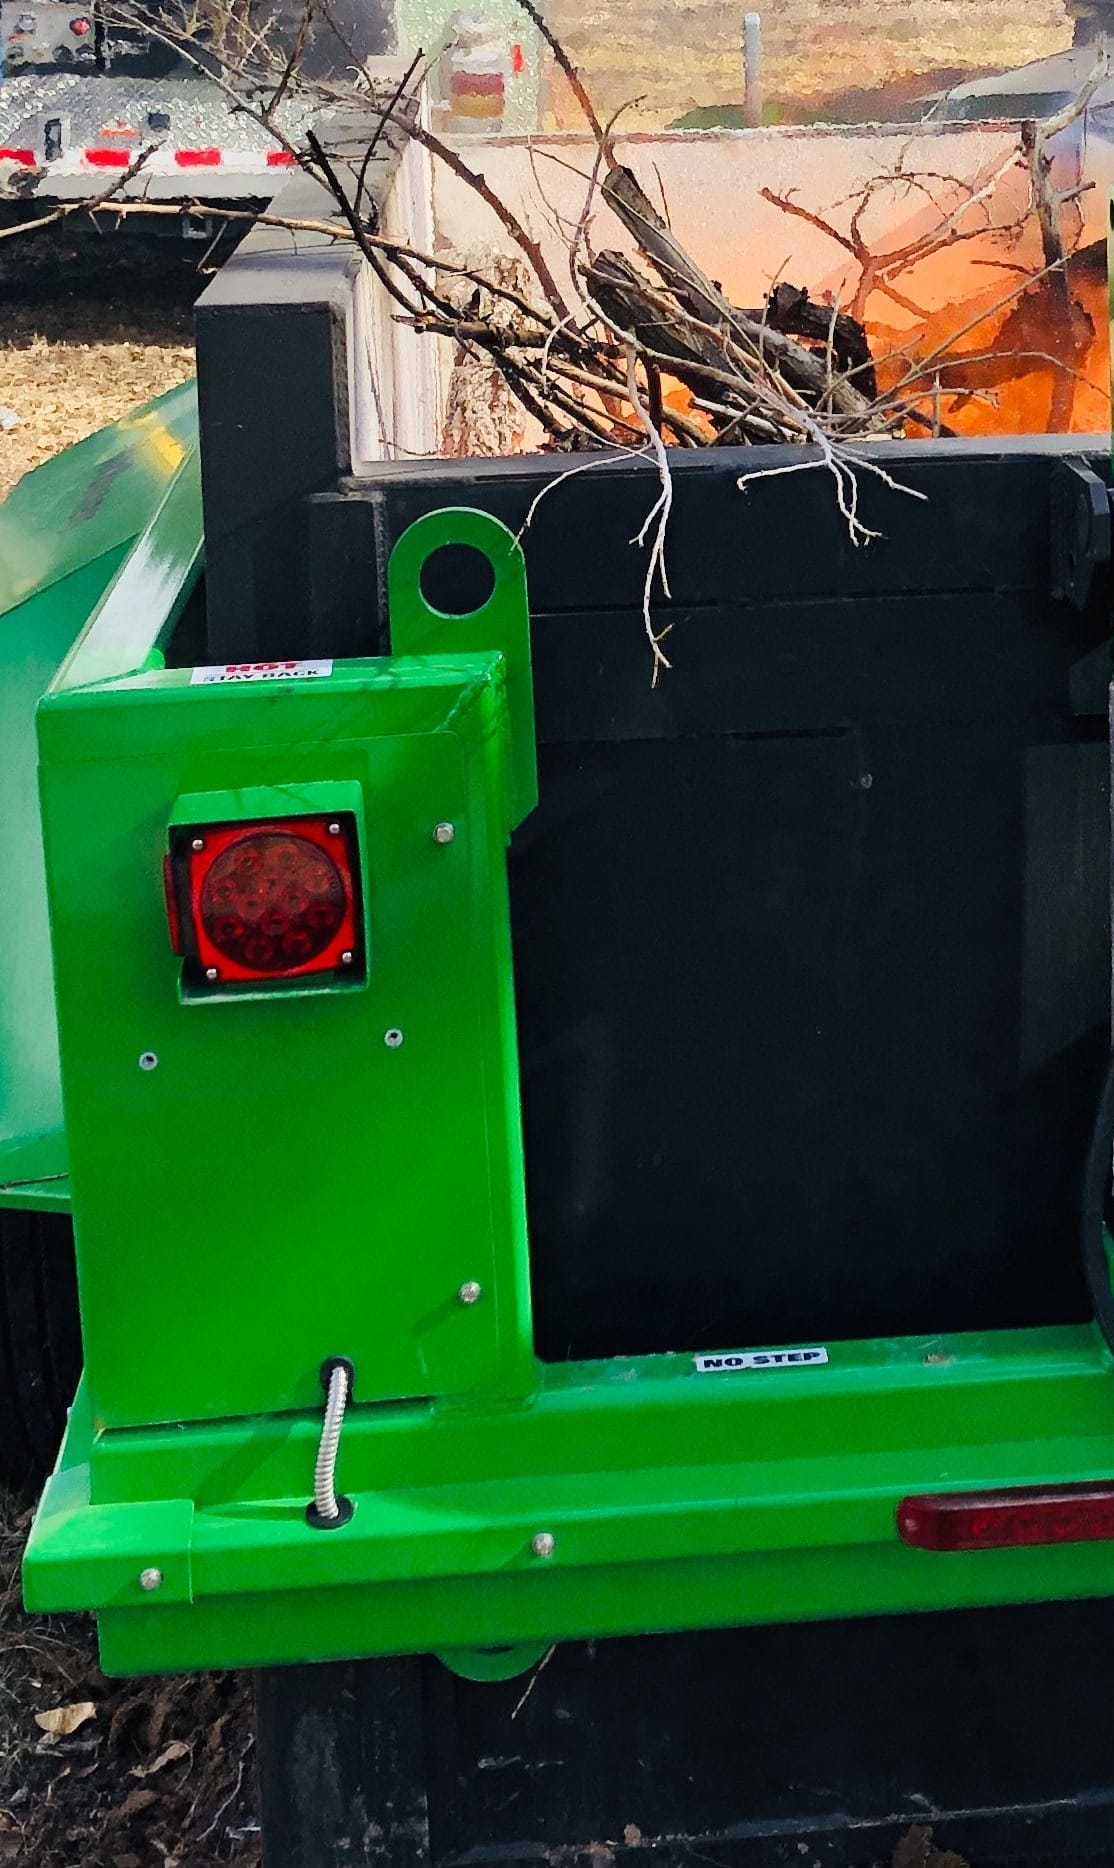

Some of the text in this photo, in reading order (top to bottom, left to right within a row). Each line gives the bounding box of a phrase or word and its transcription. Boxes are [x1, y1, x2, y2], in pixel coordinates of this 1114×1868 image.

[225, 662, 299, 673] HOT
[262, 669, 319, 678] BACK
[703, 1351, 820, 1369] NO STEP
